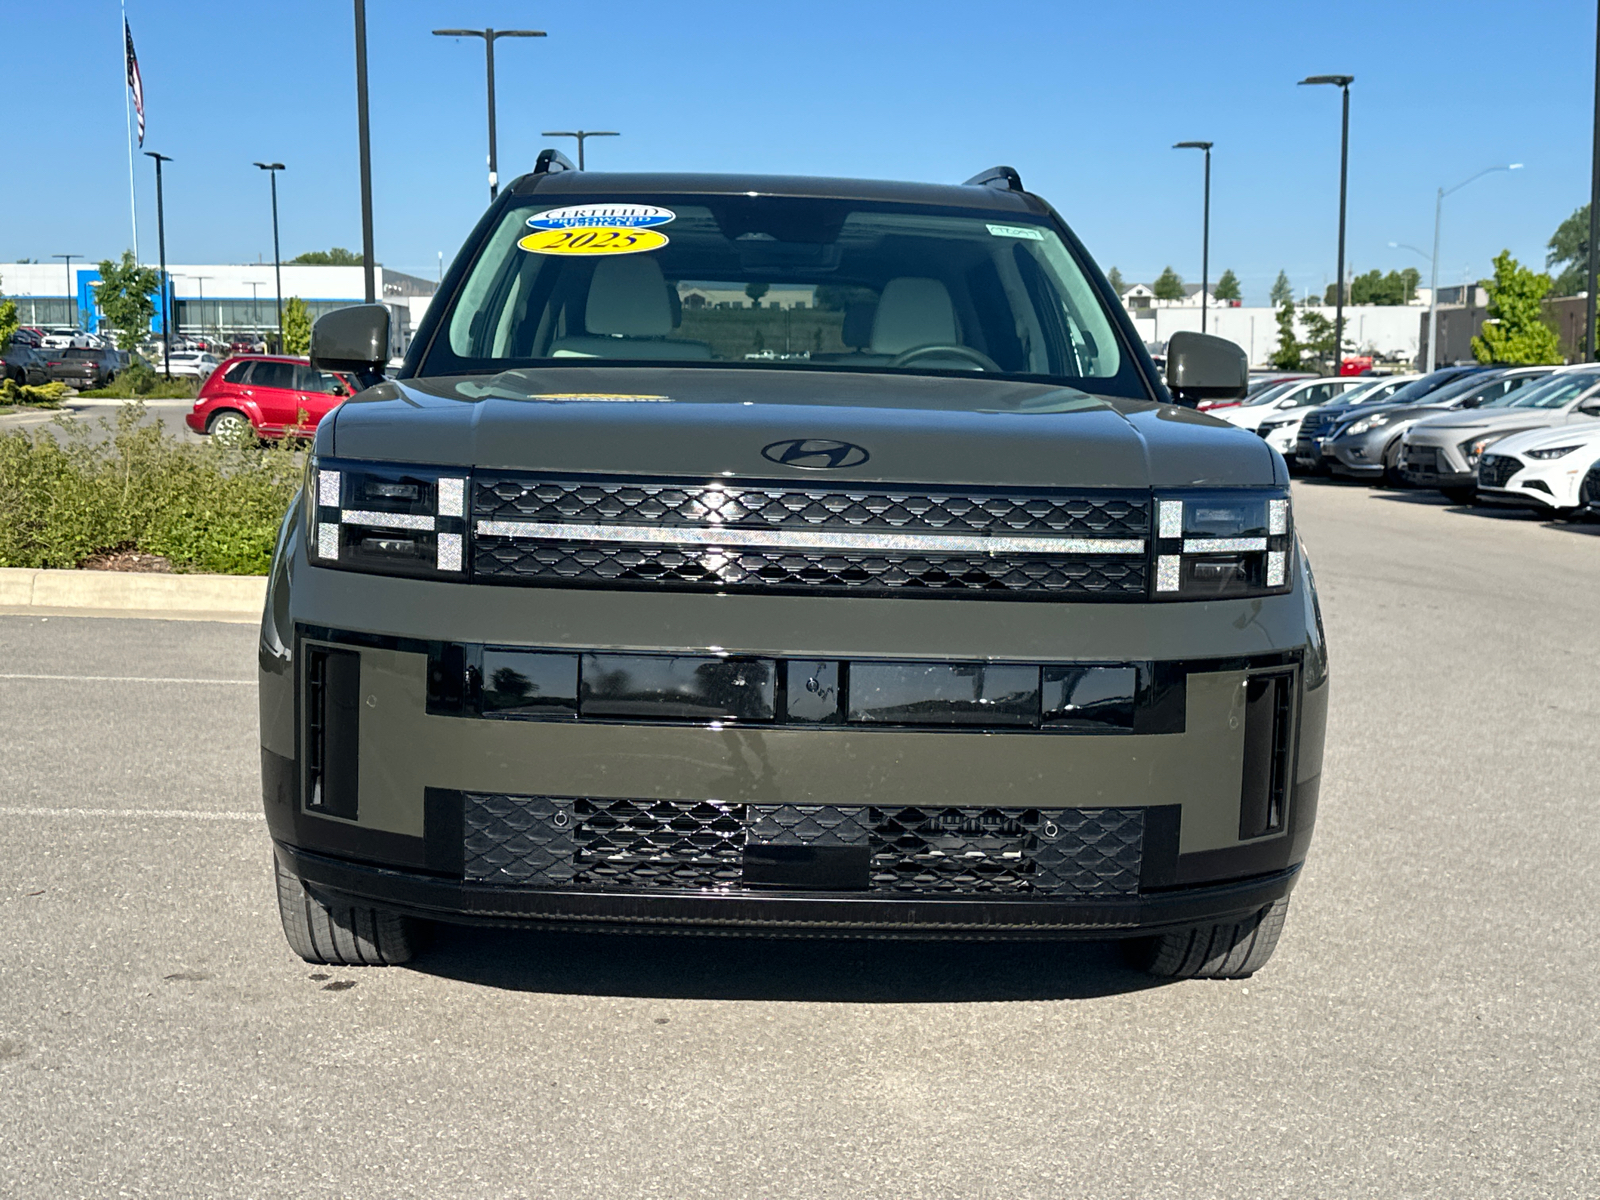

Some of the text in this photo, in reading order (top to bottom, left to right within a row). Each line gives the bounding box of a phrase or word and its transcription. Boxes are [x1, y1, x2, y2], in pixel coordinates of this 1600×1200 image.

[546, 208, 659, 219] CERTIFIED
[563, 220, 635, 228] VEHICLE
[541, 232, 646, 249] 2025
